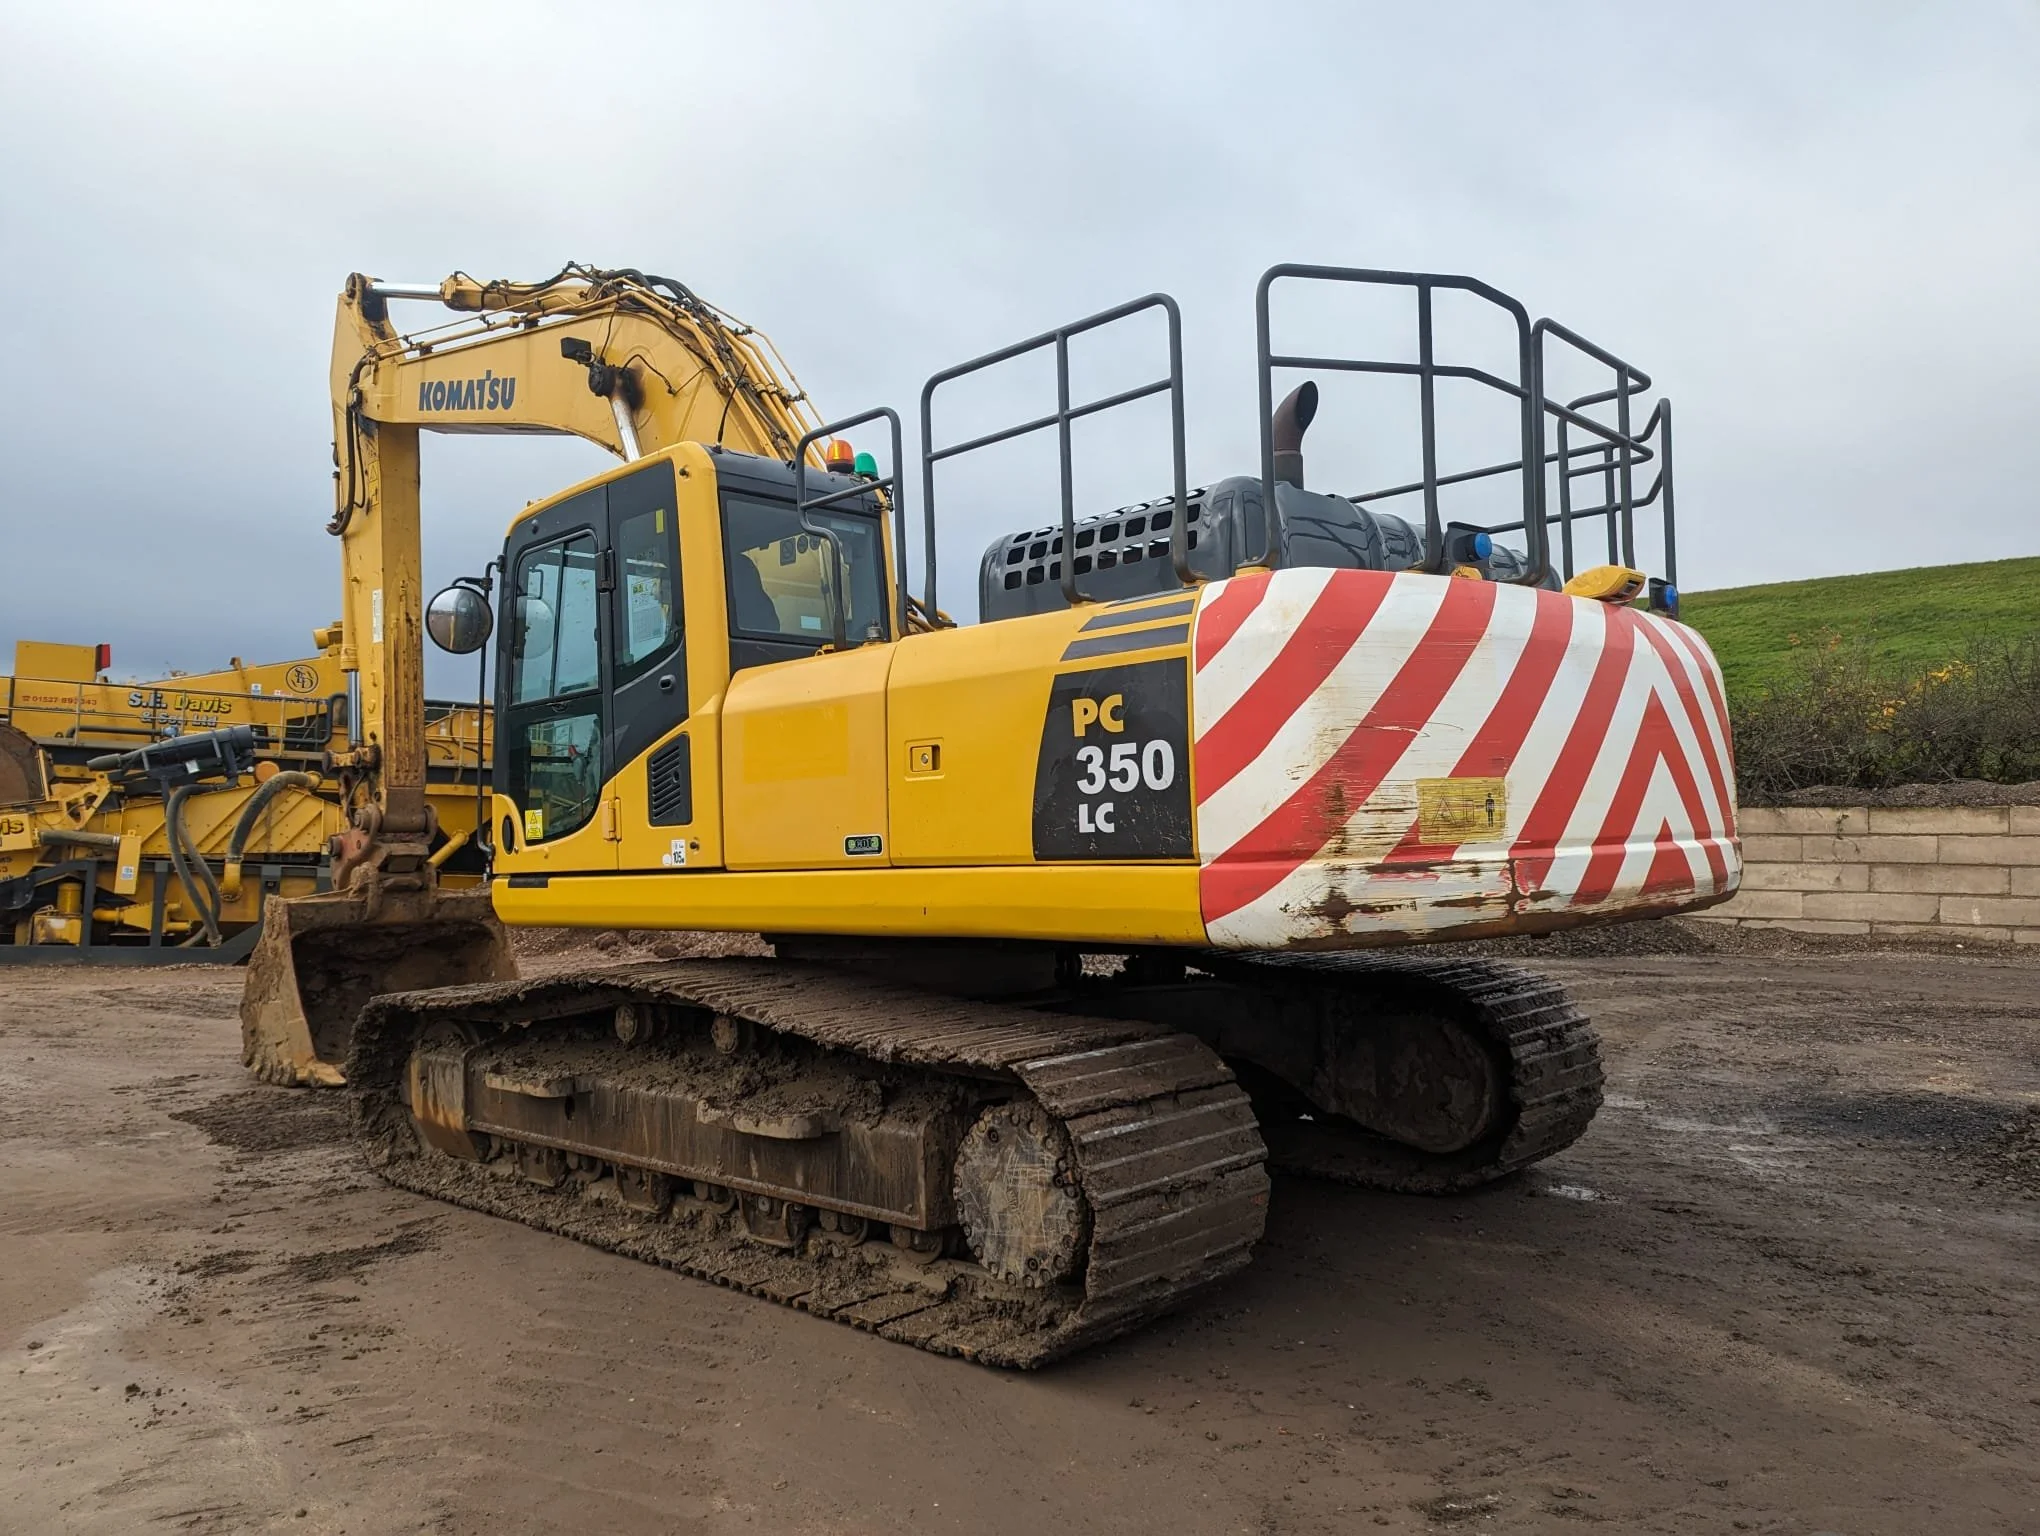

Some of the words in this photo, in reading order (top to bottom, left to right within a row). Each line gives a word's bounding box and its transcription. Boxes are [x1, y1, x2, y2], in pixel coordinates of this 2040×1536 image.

[418, 369, 516, 411] KOMATSU
[128, 691, 167, 709] S.E.
[174, 695, 232, 713] Davis
[141, 711, 153, 723] &
[192, 714, 218, 727] Ltd
[1072, 694, 1124, 737] PC
[1076, 739, 1175, 795] 350
[1078, 802, 1115, 833] LC
